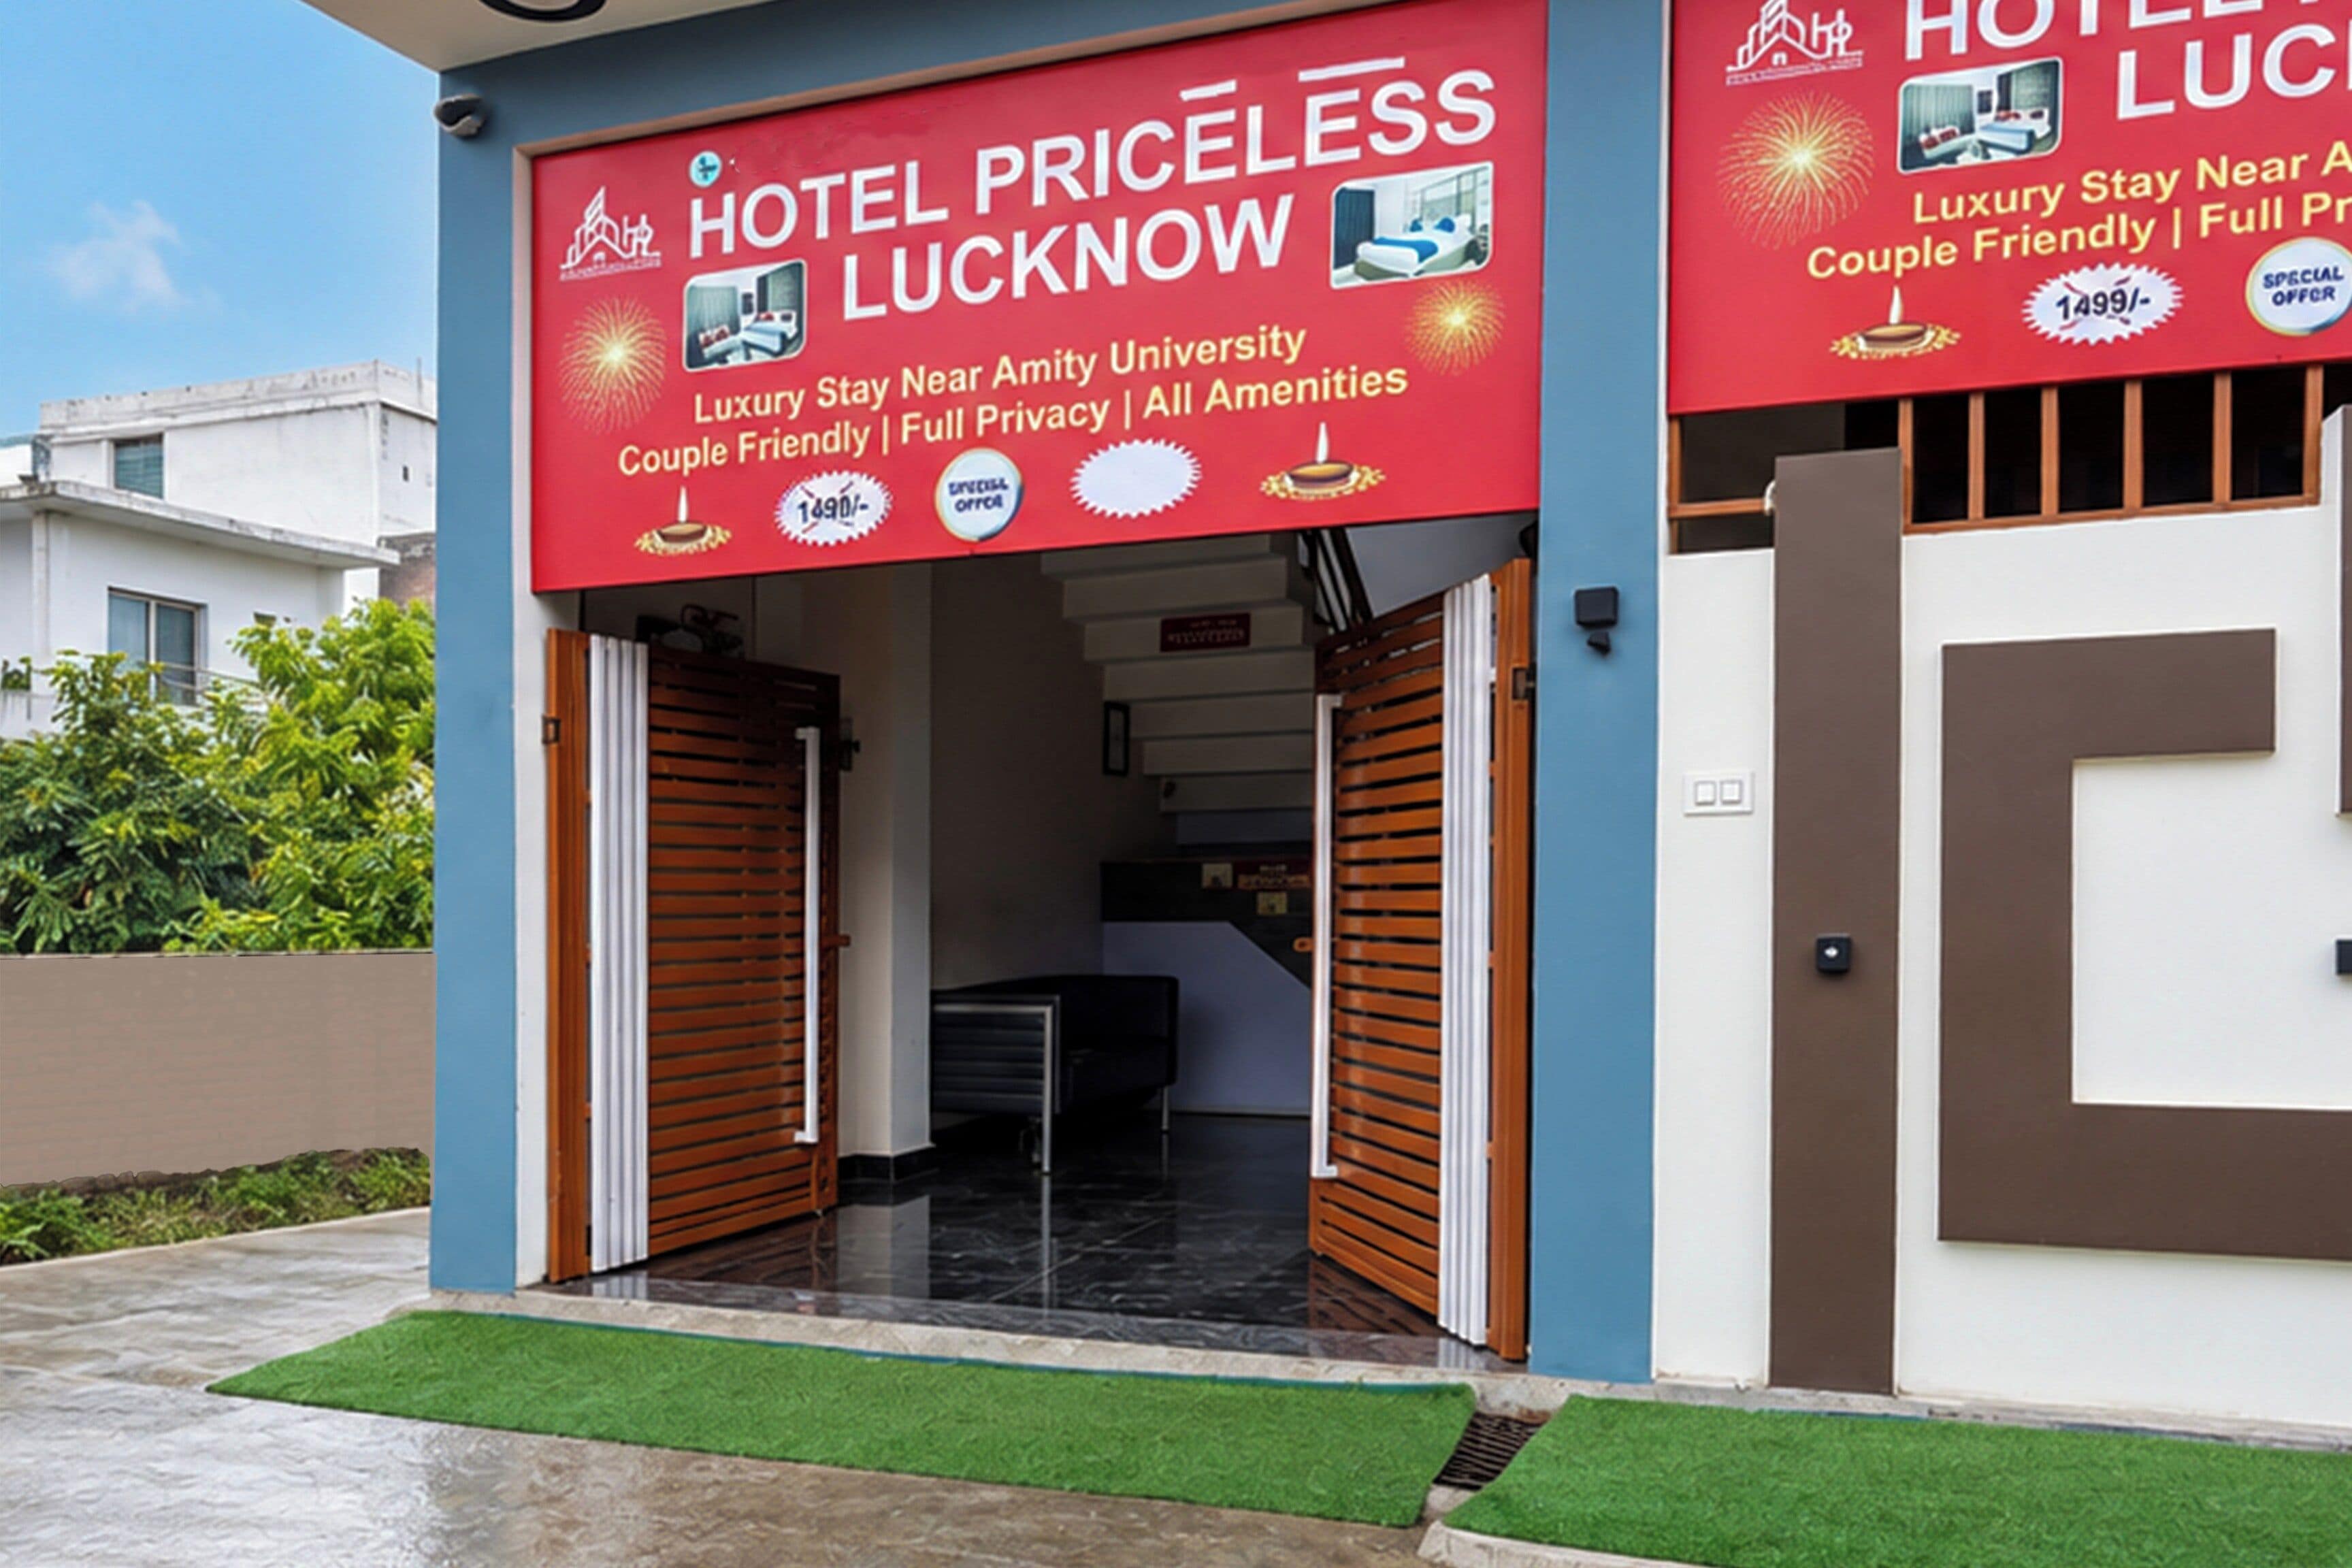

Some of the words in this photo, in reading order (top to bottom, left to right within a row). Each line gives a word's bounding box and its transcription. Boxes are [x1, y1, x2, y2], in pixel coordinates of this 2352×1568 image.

[2117, 19, 2352, 120] LUC
[690, 160, 949, 259] HOTEL
[976, 69, 1495, 215] PRICELESS
[1914, 182, 2065, 224] Luxury
[2080, 169, 2180, 203] Stay
[2197, 154, 2309, 191] Near
[843, 193, 1294, 321] LUCKNOW
[1808, 235, 1958, 278] Couple
[1974, 212, 2156, 261] Friendly
[2200, 195, 2283, 238] Full
[2263, 265, 2345, 289] SPECIAL
[2272, 285, 2336, 306] OFFER
[619, 436, 728, 476] Couple
[738, 421, 870, 463] Friendly
[901, 407, 964, 444] Full
[977, 399, 1111, 437] Privacy
[1143, 382, 1192, 419] All
[1204, 368, 1408, 413] Amenities
[695, 389, 805, 423] Luxury
[817, 376, 890, 411] Stay
[902, 365, 983, 398] Near
[992, 349, 1098, 389] Amity
[1110, 325, 1306, 374] University
